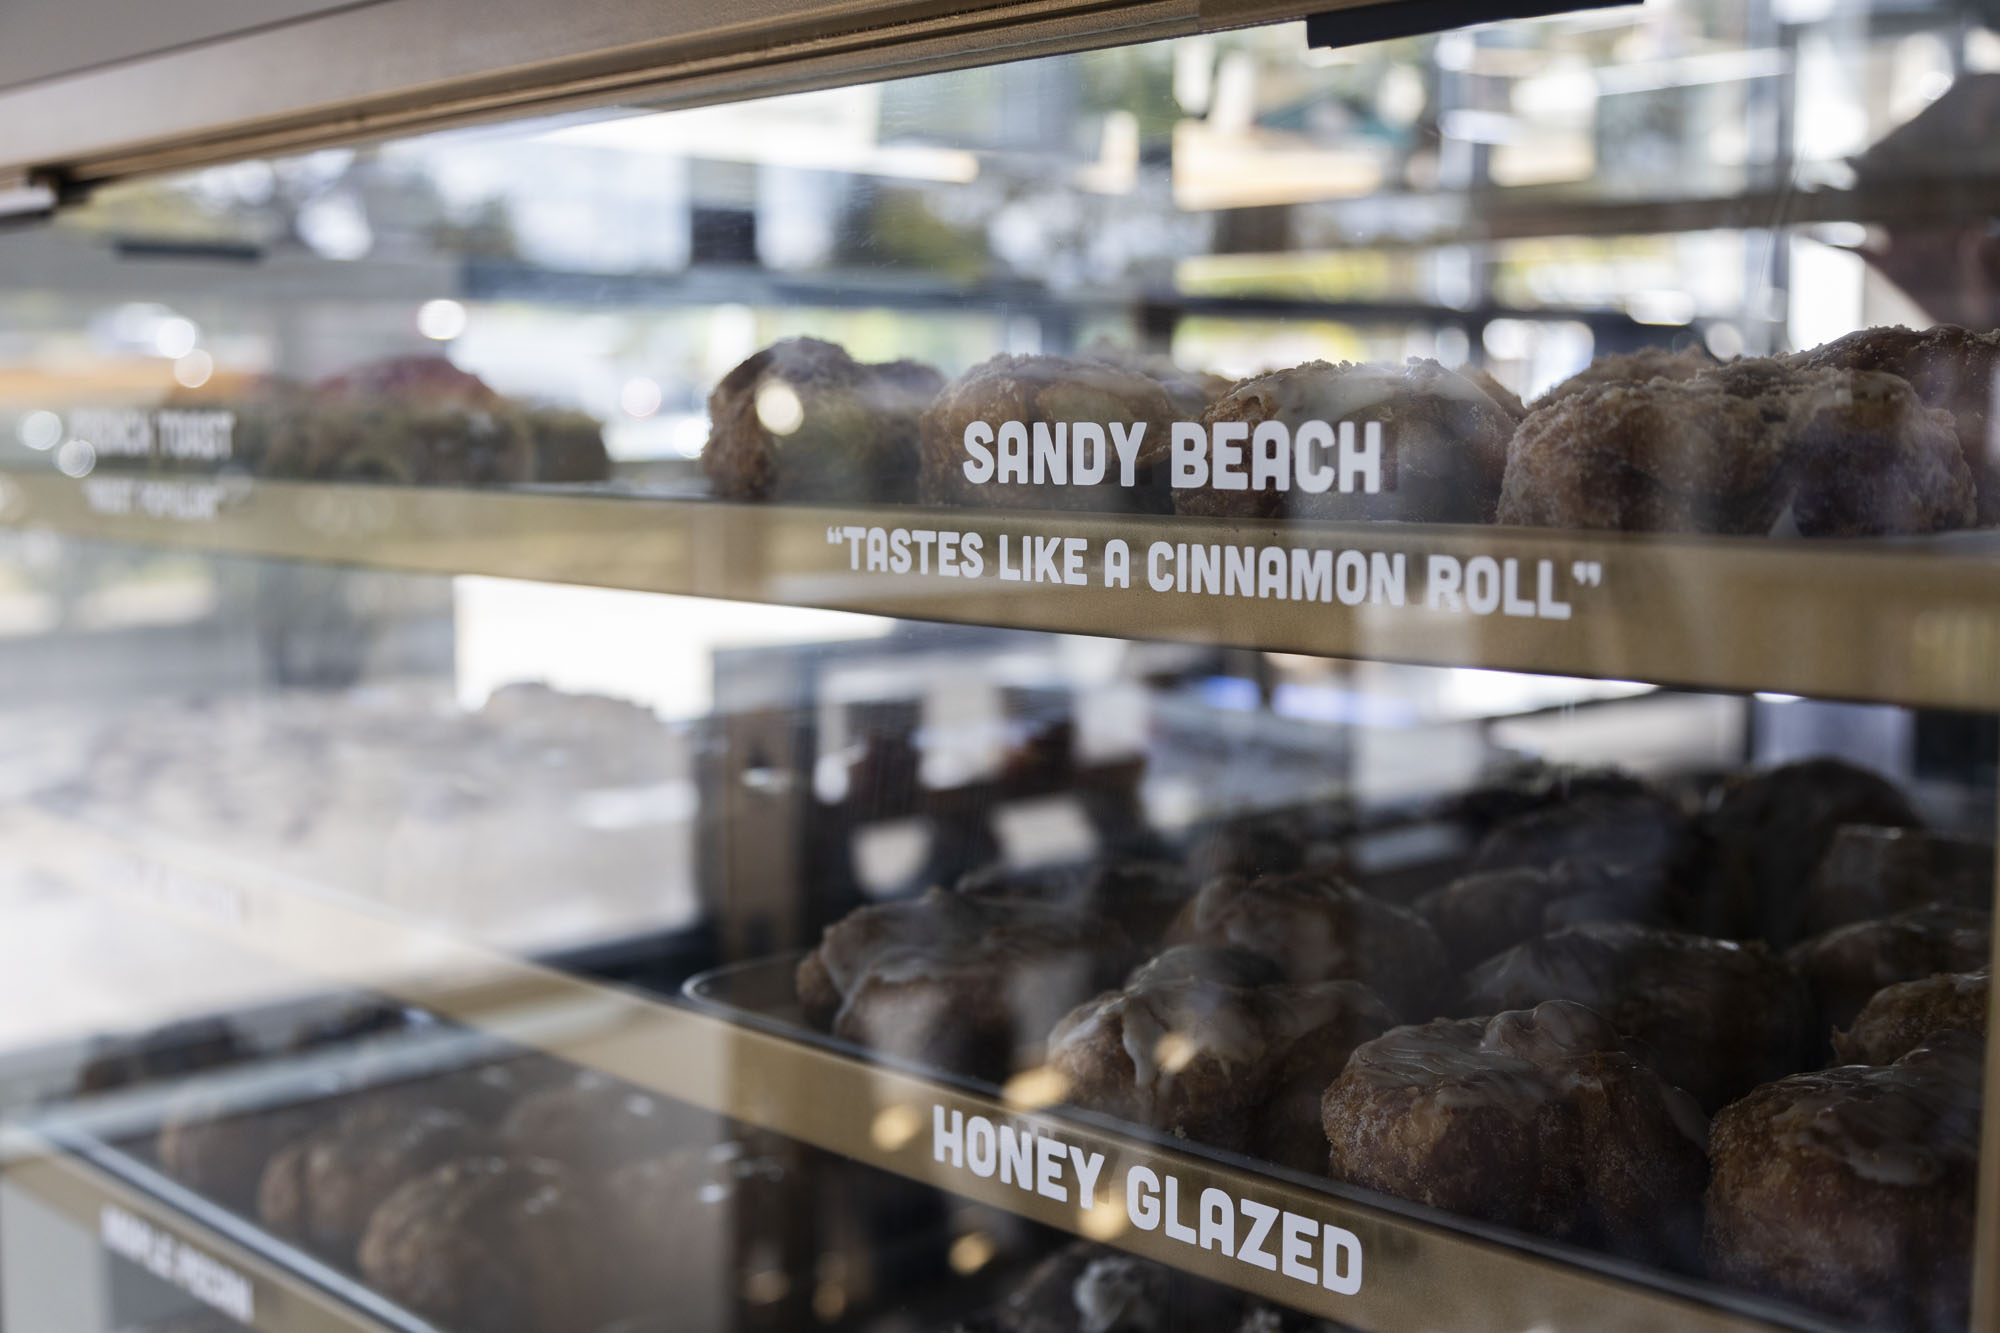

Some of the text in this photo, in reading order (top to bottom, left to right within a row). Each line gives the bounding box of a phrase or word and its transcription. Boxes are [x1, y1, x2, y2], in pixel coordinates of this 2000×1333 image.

[963, 421, 1382, 494] SANDY BEACH
[827, 526, 1602, 620] “TASTES LIKE A CINNAMON ROLL”
[933, 1104, 1363, 1295] HONEY GLAZED
